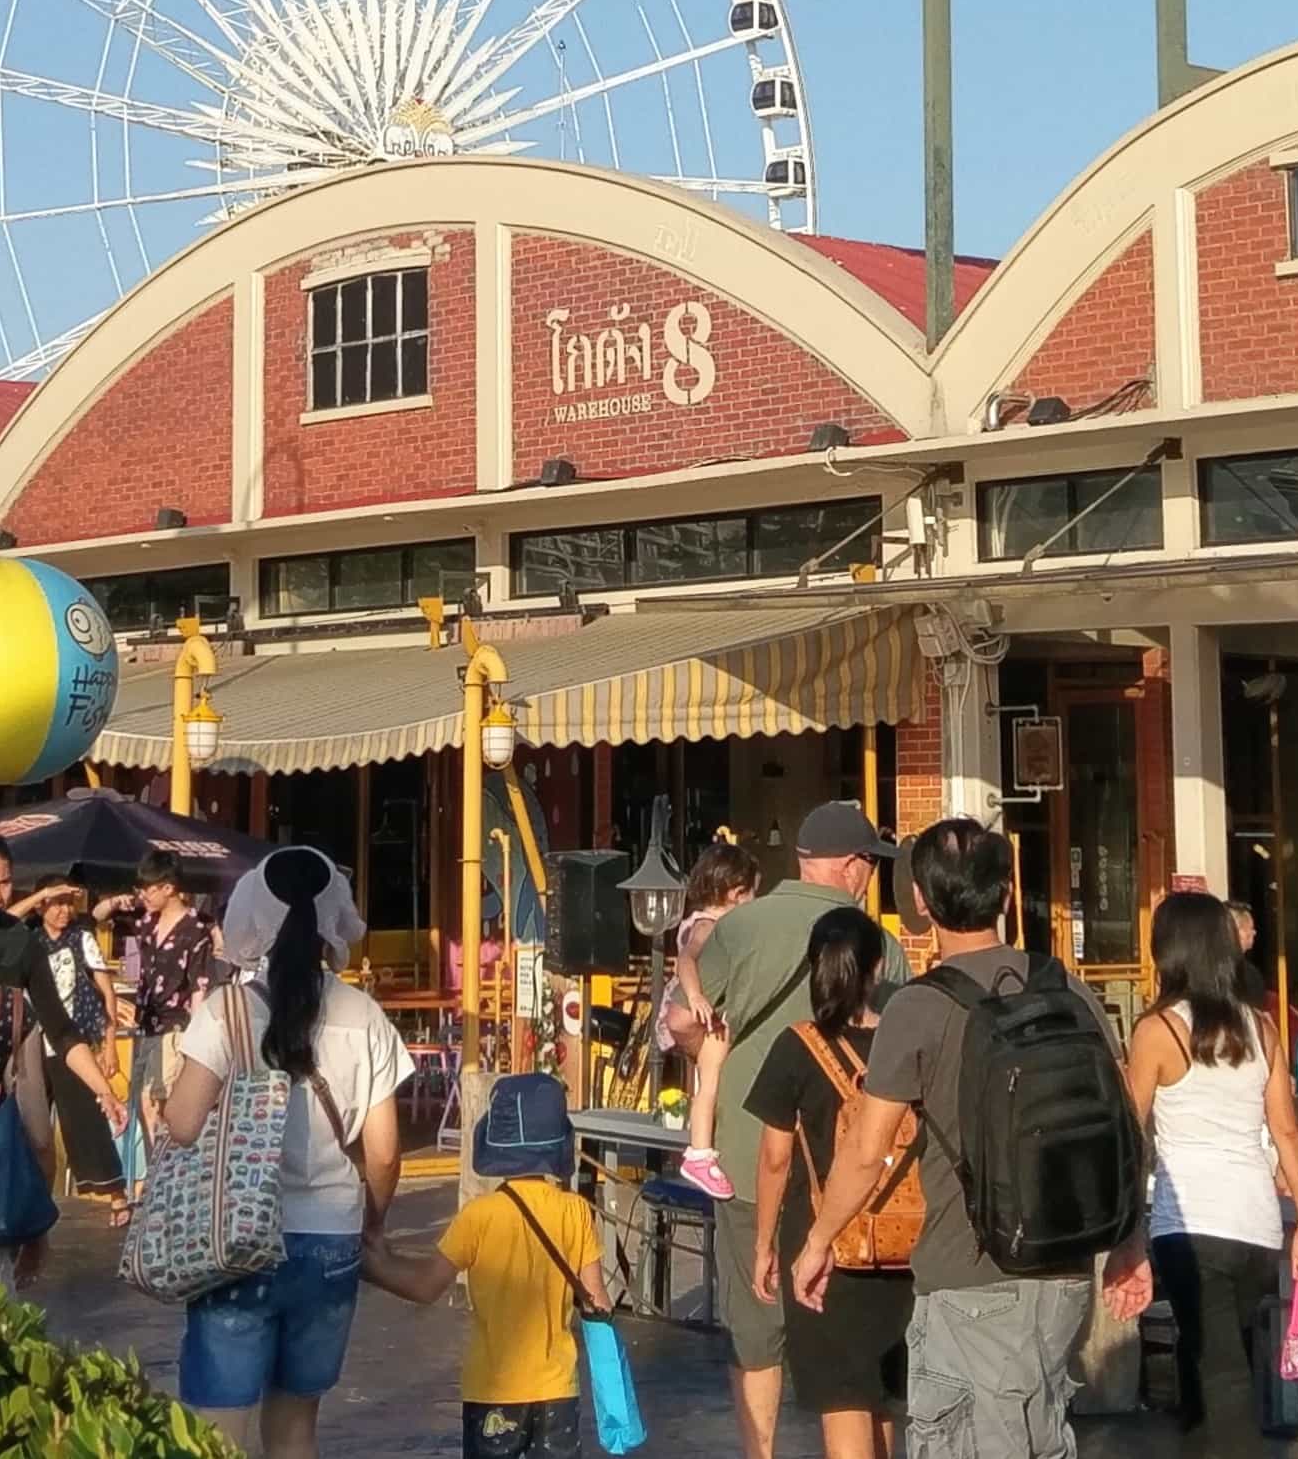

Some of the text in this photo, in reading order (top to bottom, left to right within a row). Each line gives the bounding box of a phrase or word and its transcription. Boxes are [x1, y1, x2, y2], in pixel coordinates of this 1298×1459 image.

[545, 301, 716, 405] โกดัง 8
[553, 393, 652, 424] WAREHOUSE
